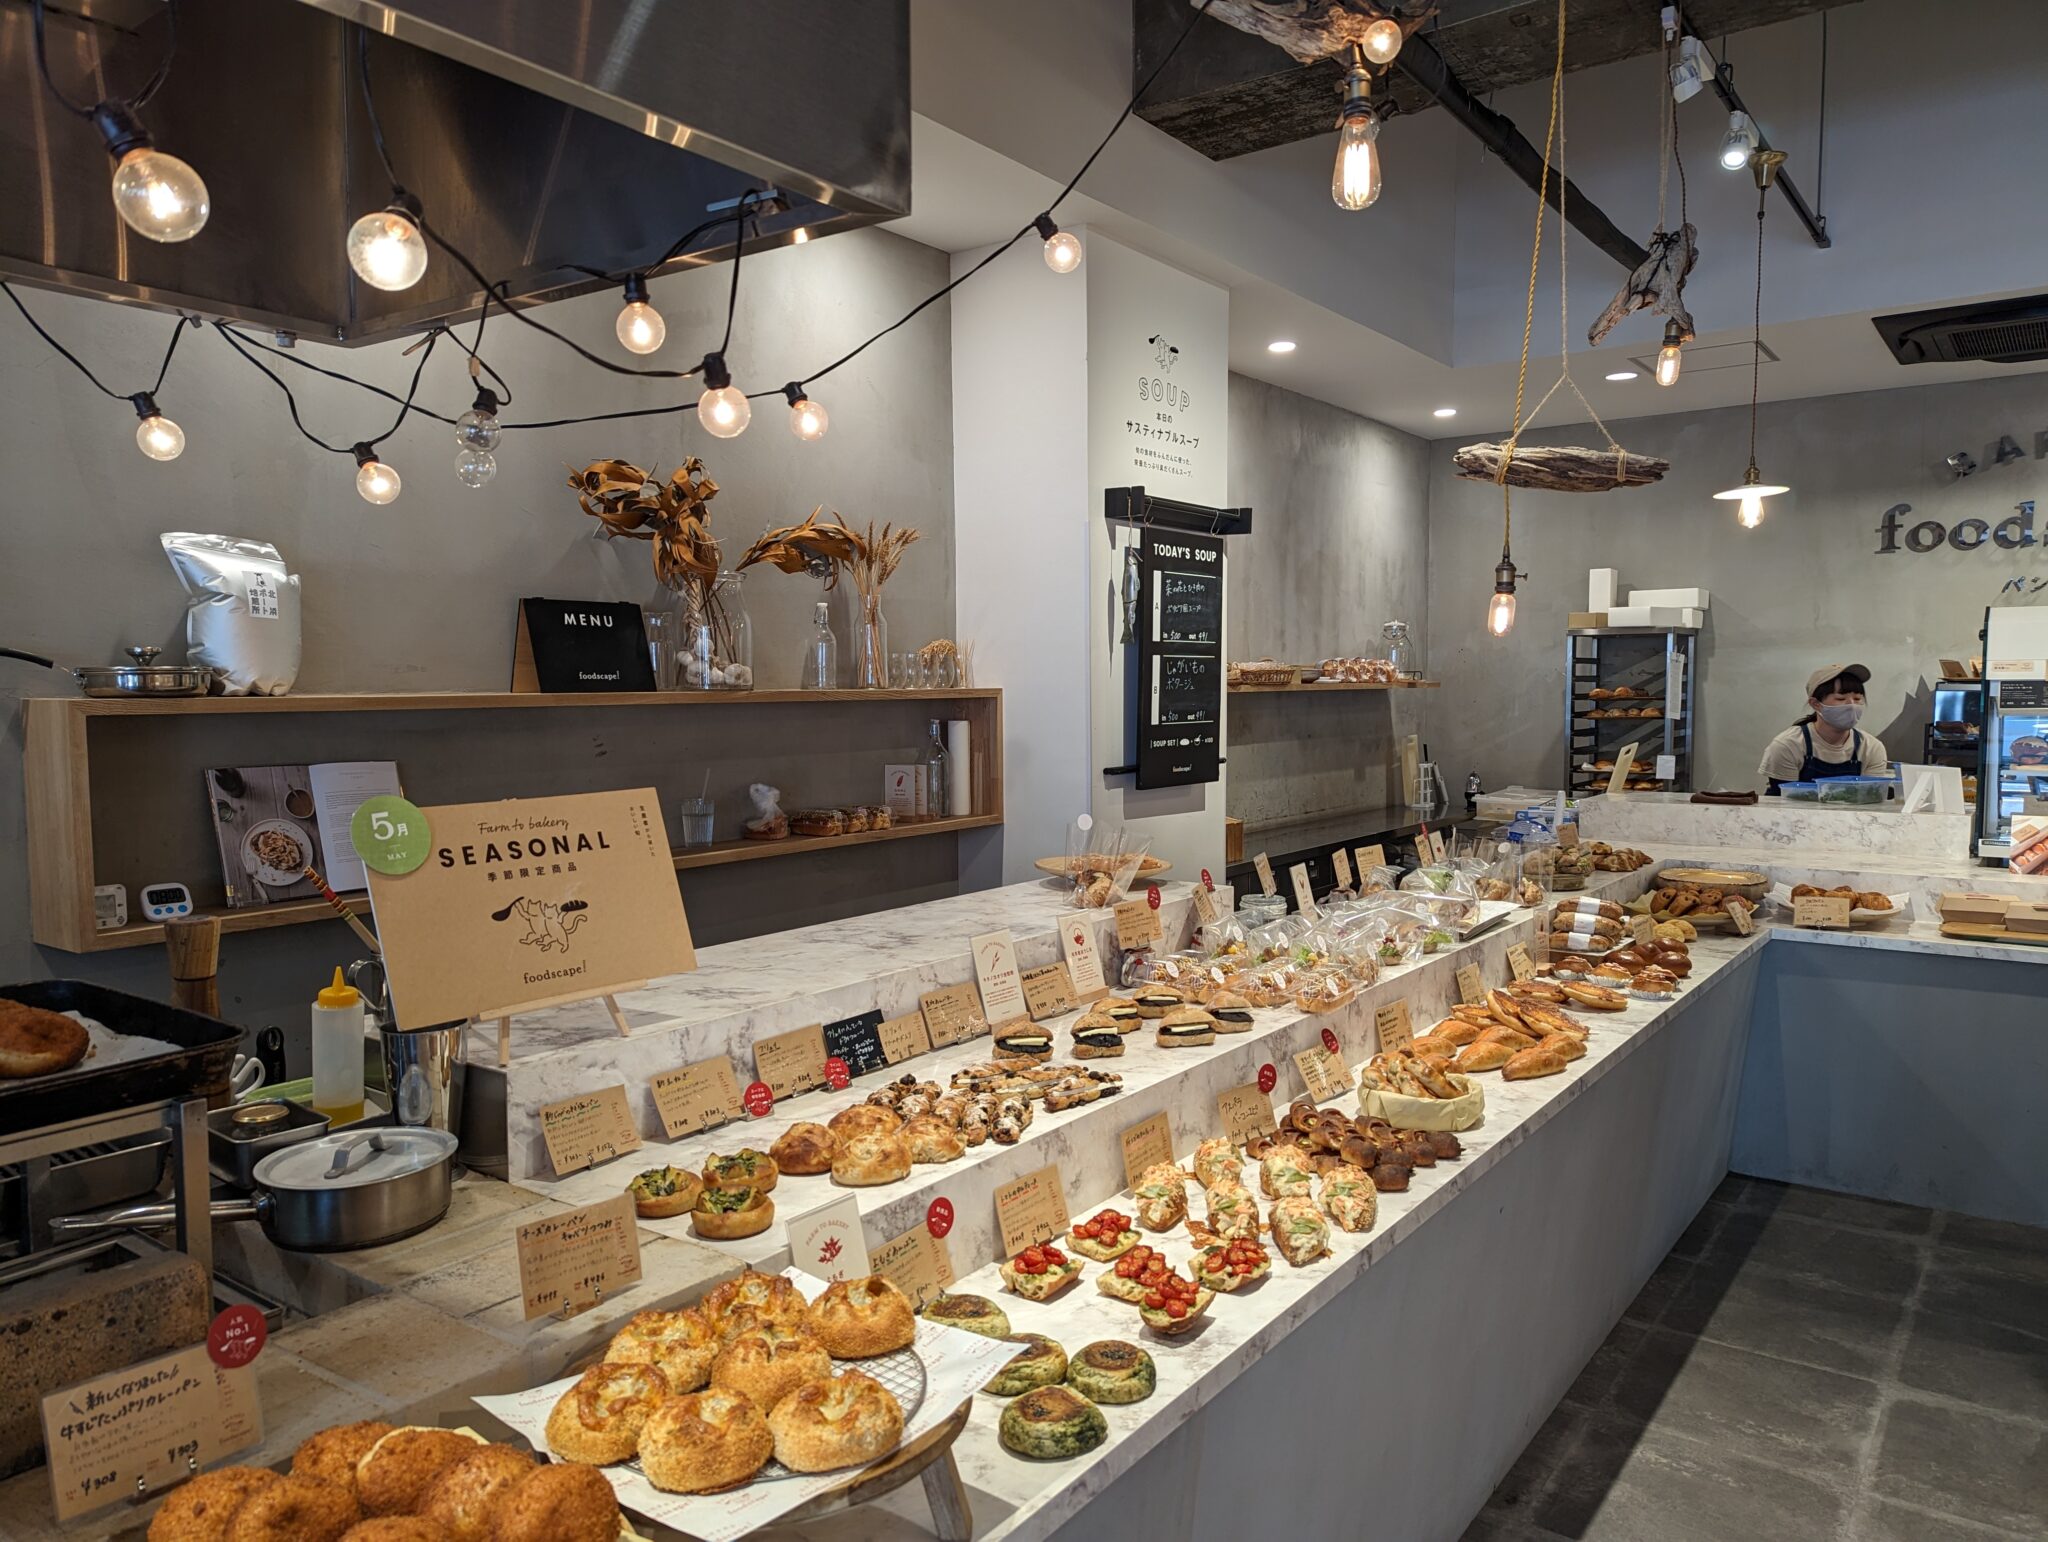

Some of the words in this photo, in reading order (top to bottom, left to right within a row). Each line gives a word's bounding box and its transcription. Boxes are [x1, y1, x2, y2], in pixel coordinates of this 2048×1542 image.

[1138, 377, 1191, 412] SOUP
[1156, 412, 1173, 424] 本日の
[1126, 419, 1200, 449] サスティナブルスープ
[1873, 500, 2048, 555] food
[1153, 543, 1191, 560] TODAY'S
[1195, 548, 1217, 563] SOUP
[564, 612, 614, 628] MENU
[579, 670, 621, 681] foodscape!
[1166, 659, 1206, 676] じゃがいもの
[1153, 740, 1167, 748] SOUP
[370, 811, 409, 841] 5月
[477, 822, 511, 836] Farm
[511, 818, 525, 831] to
[529, 816, 570, 831] bakery
[386, 850, 408, 862] MAY
[438, 830, 611, 868] SEASONAL
[487, 861, 578, 883] 季節限定商品
[523, 959, 588, 984] foodscape!
[521, 1213, 588, 1241] チーズカレーパン
[561, 1219, 613, 1242] キャベツつつみ
[80, 1470, 118, 1497] ¥308
[167, 1439, 200, 1464] ¥303
